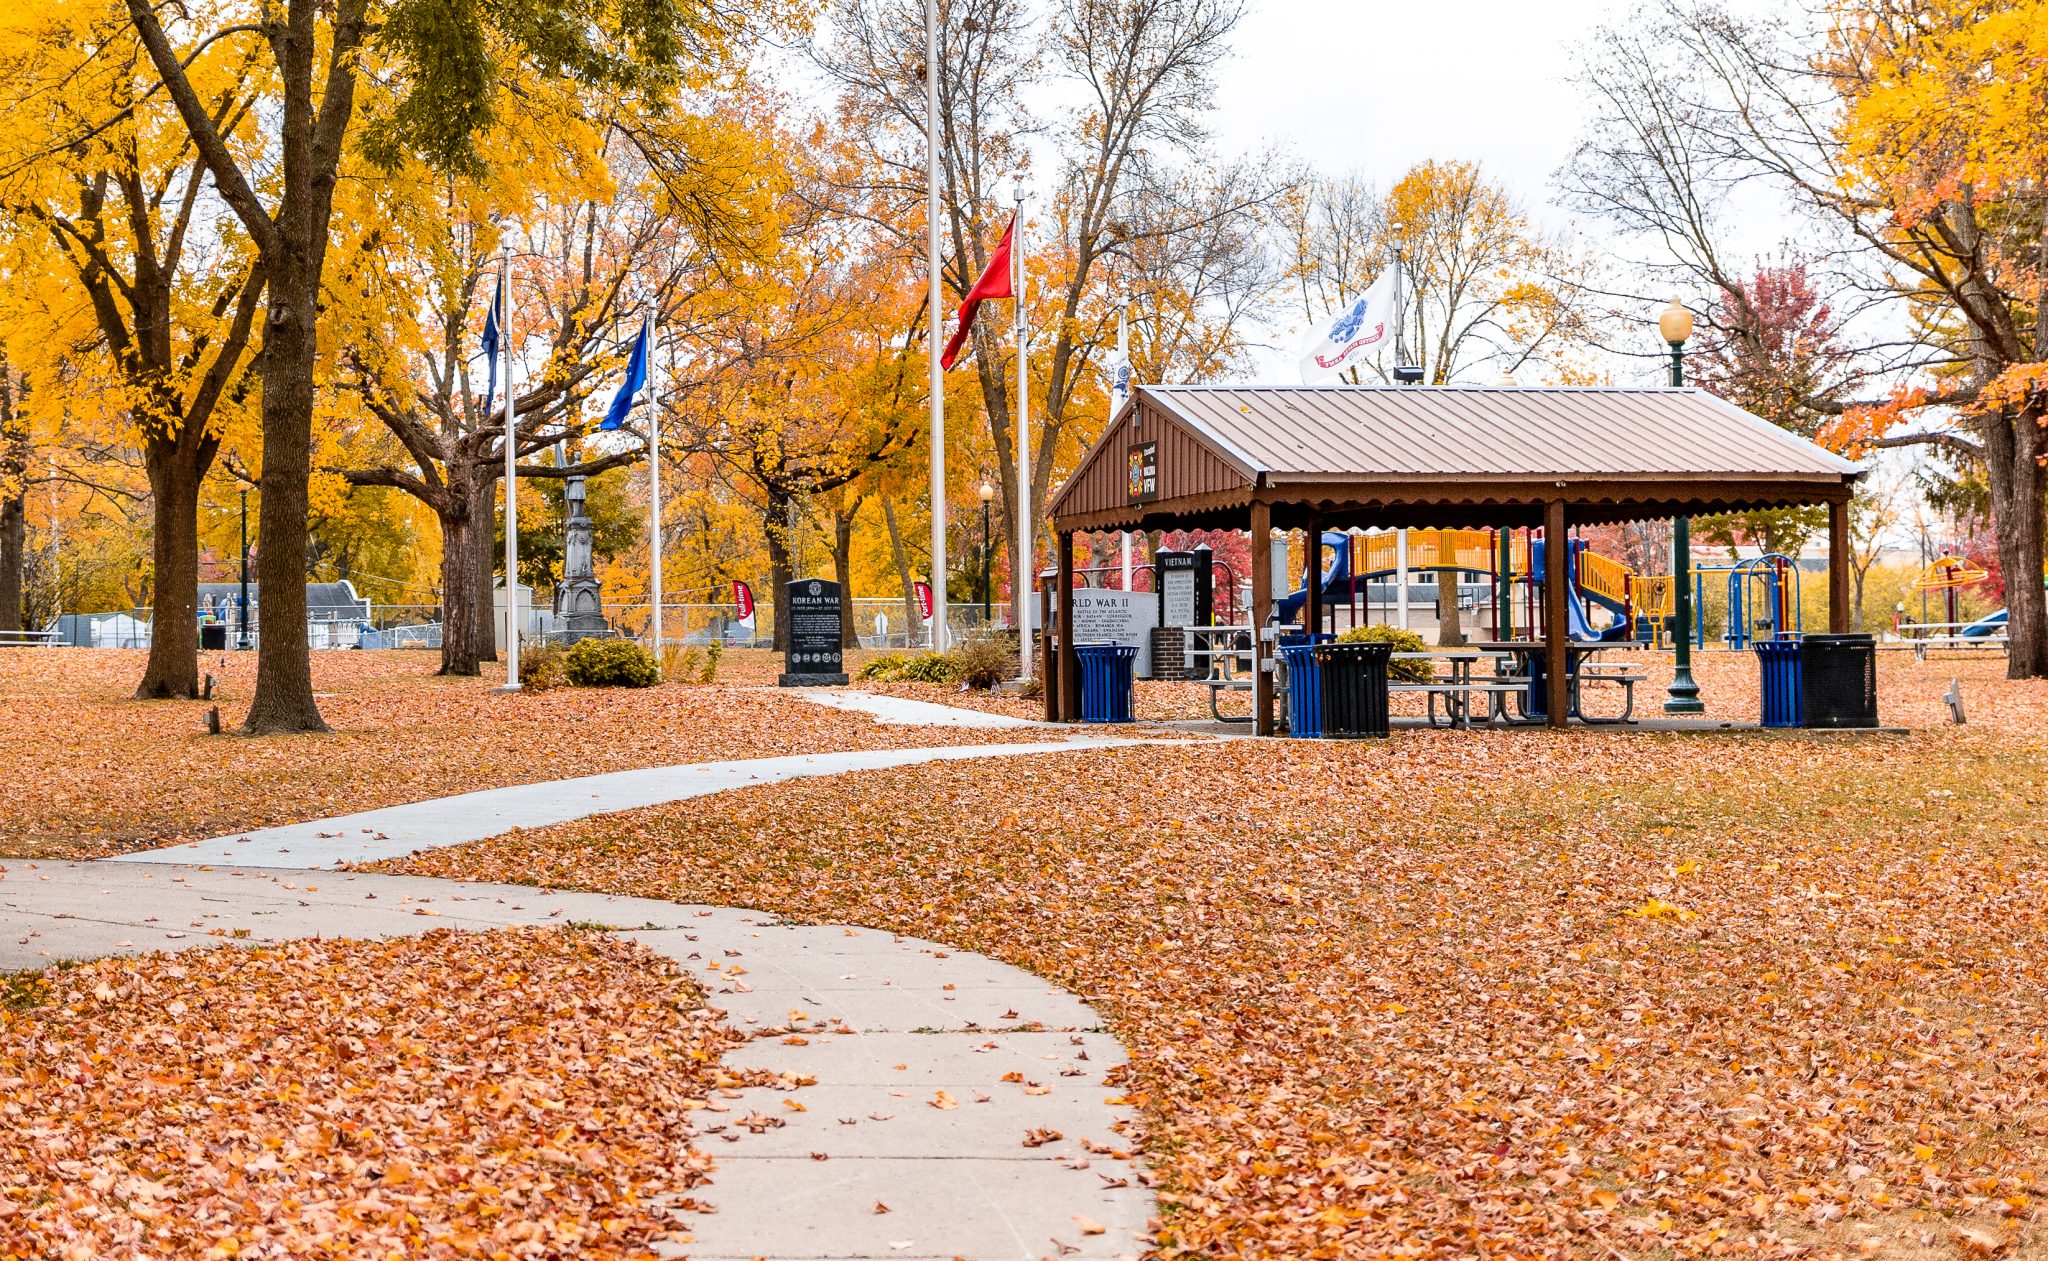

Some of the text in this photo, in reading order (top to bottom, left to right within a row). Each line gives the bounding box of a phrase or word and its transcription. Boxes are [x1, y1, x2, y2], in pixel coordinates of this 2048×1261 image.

[1143, 477, 1156, 494] VFW
[1164, 557, 1192, 567] VIETNAM
[737, 585, 747, 617] Full-time
[917, 585, 929, 617] Part-time
[1073, 598, 1128, 607] RLD WAR II
